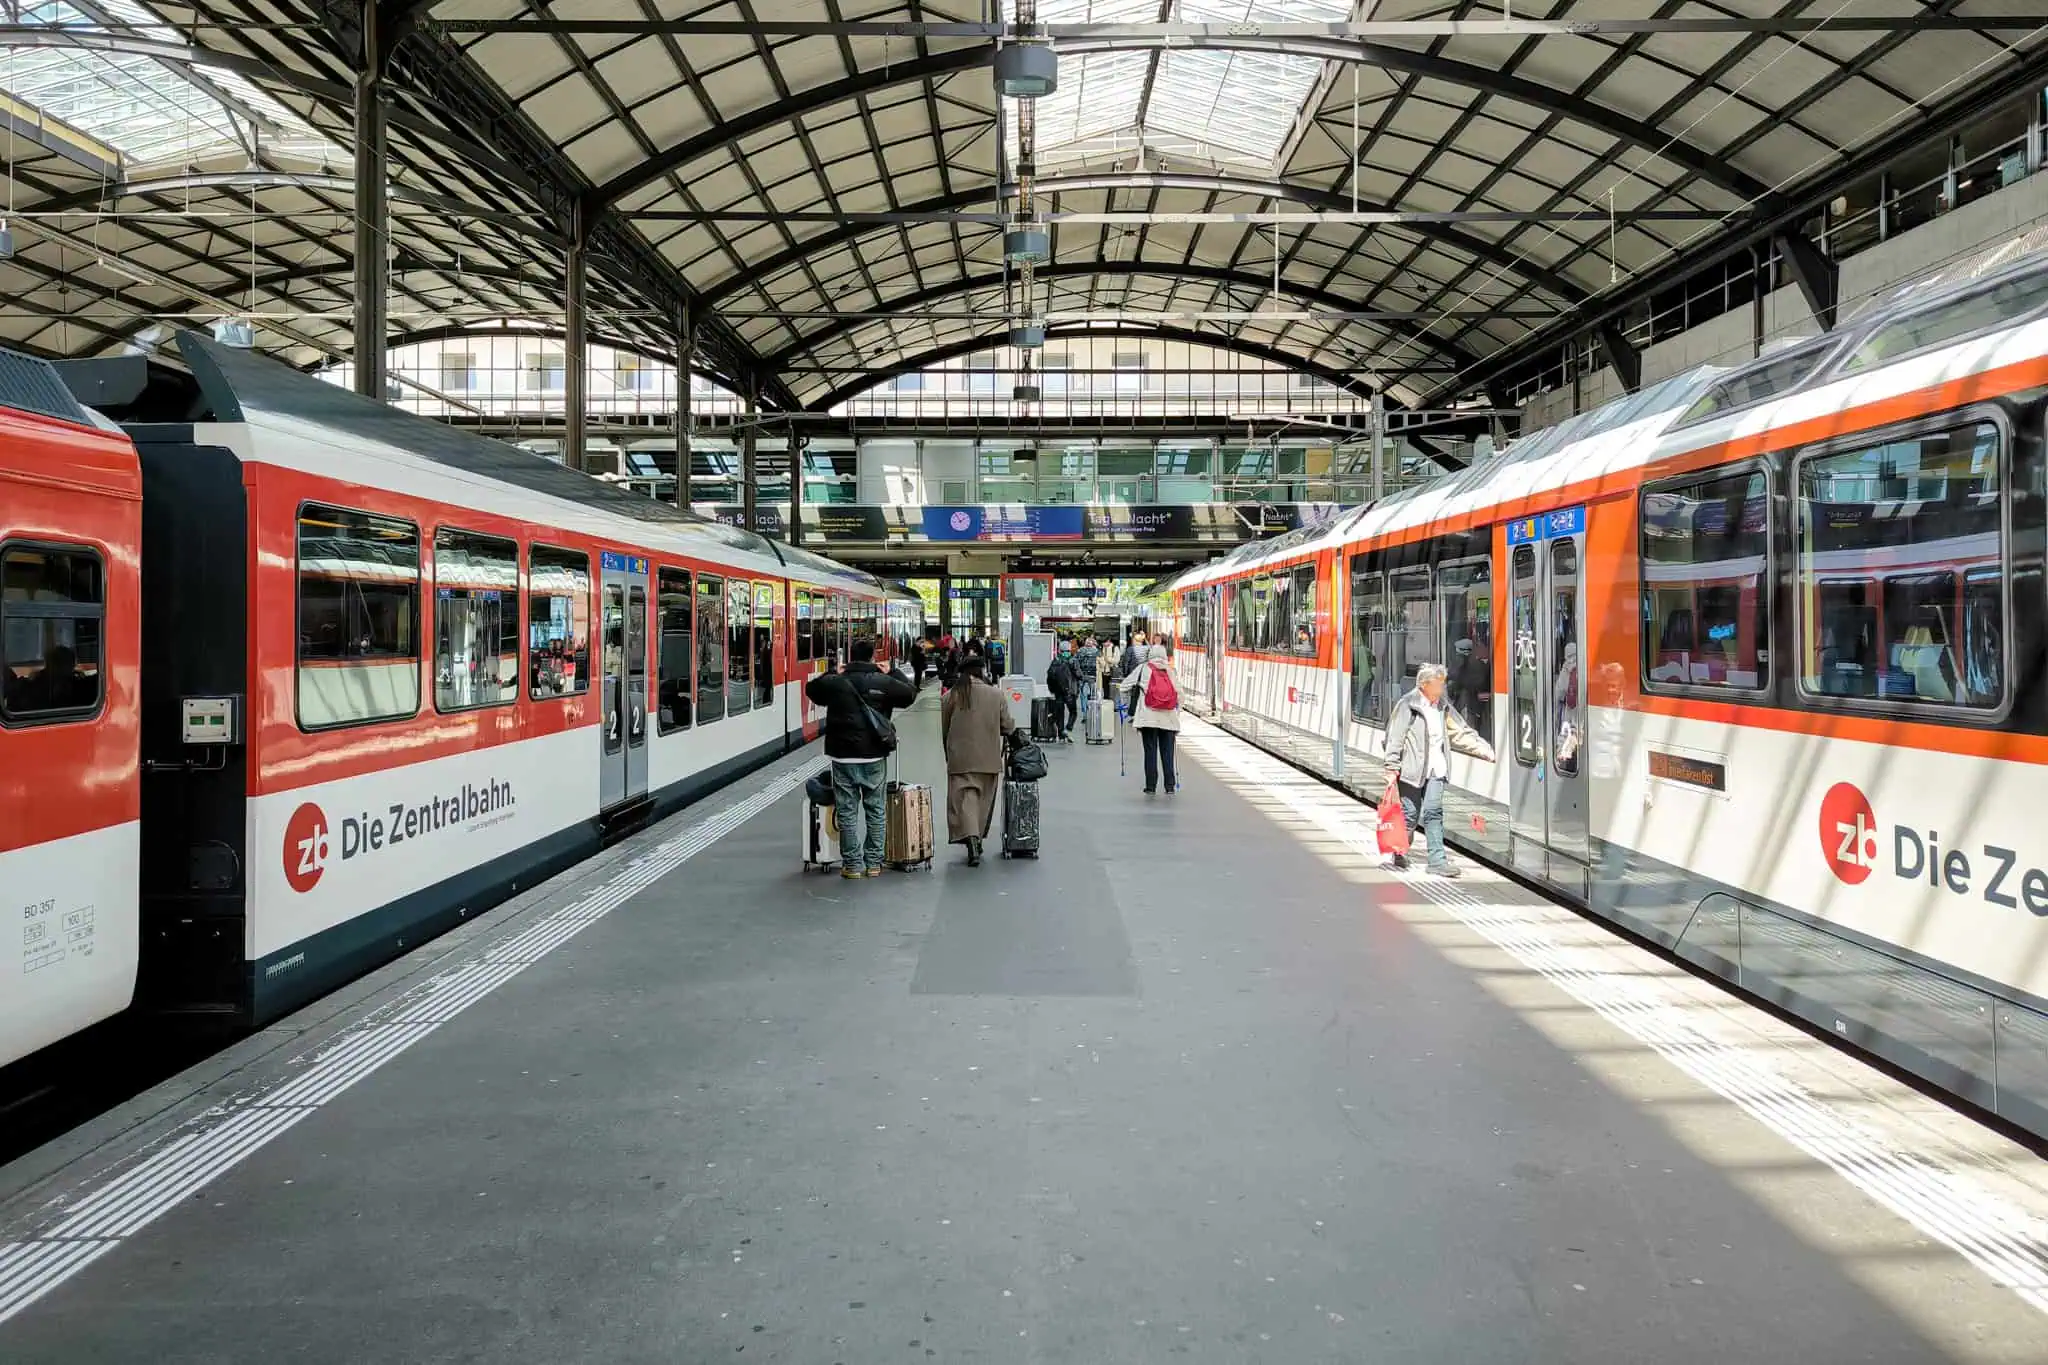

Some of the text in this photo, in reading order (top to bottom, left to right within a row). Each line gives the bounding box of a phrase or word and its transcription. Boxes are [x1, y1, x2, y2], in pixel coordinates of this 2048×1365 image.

[1088, 512, 1111, 526] Tag
[610, 710, 617, 740] 2
[632, 705, 640, 734] 2
[1522, 714, 1532, 749] 2
[342, 777, 516, 860] Die Zentralbahn.
[1836, 812, 1877, 868] zb
[297, 824, 329, 876] zb
[1894, 823, 1971, 895] Die
